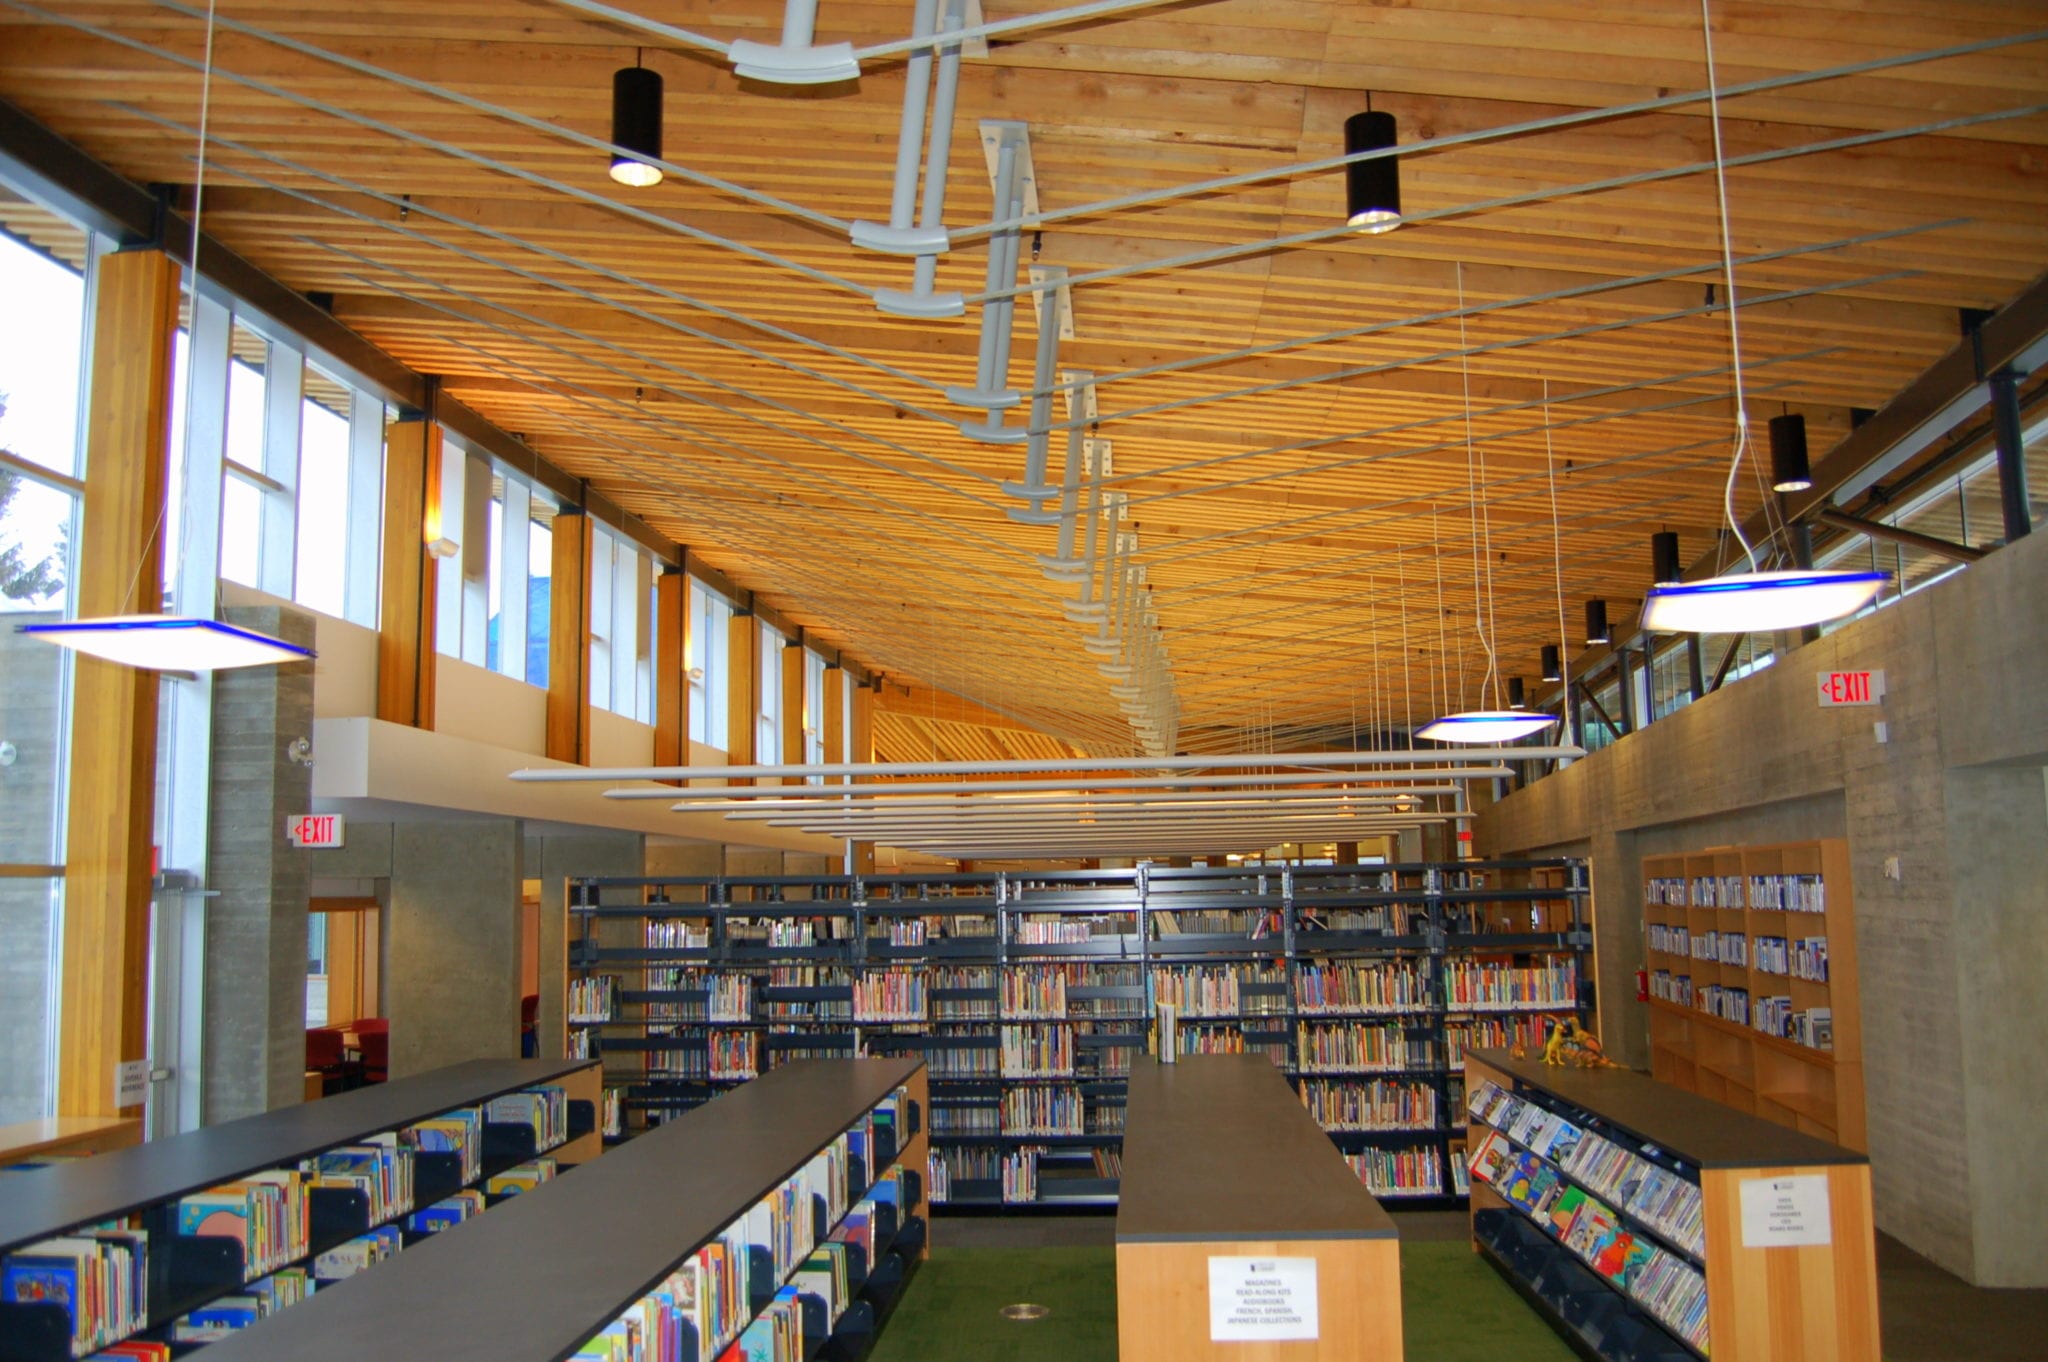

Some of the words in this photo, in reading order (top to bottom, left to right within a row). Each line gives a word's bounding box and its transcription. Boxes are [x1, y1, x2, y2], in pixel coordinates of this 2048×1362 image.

[1830, 672, 1870, 702] EXIT
[303, 816, 335, 843] EXIT
[1259, 1316, 1302, 1324] COLLECTIONS
